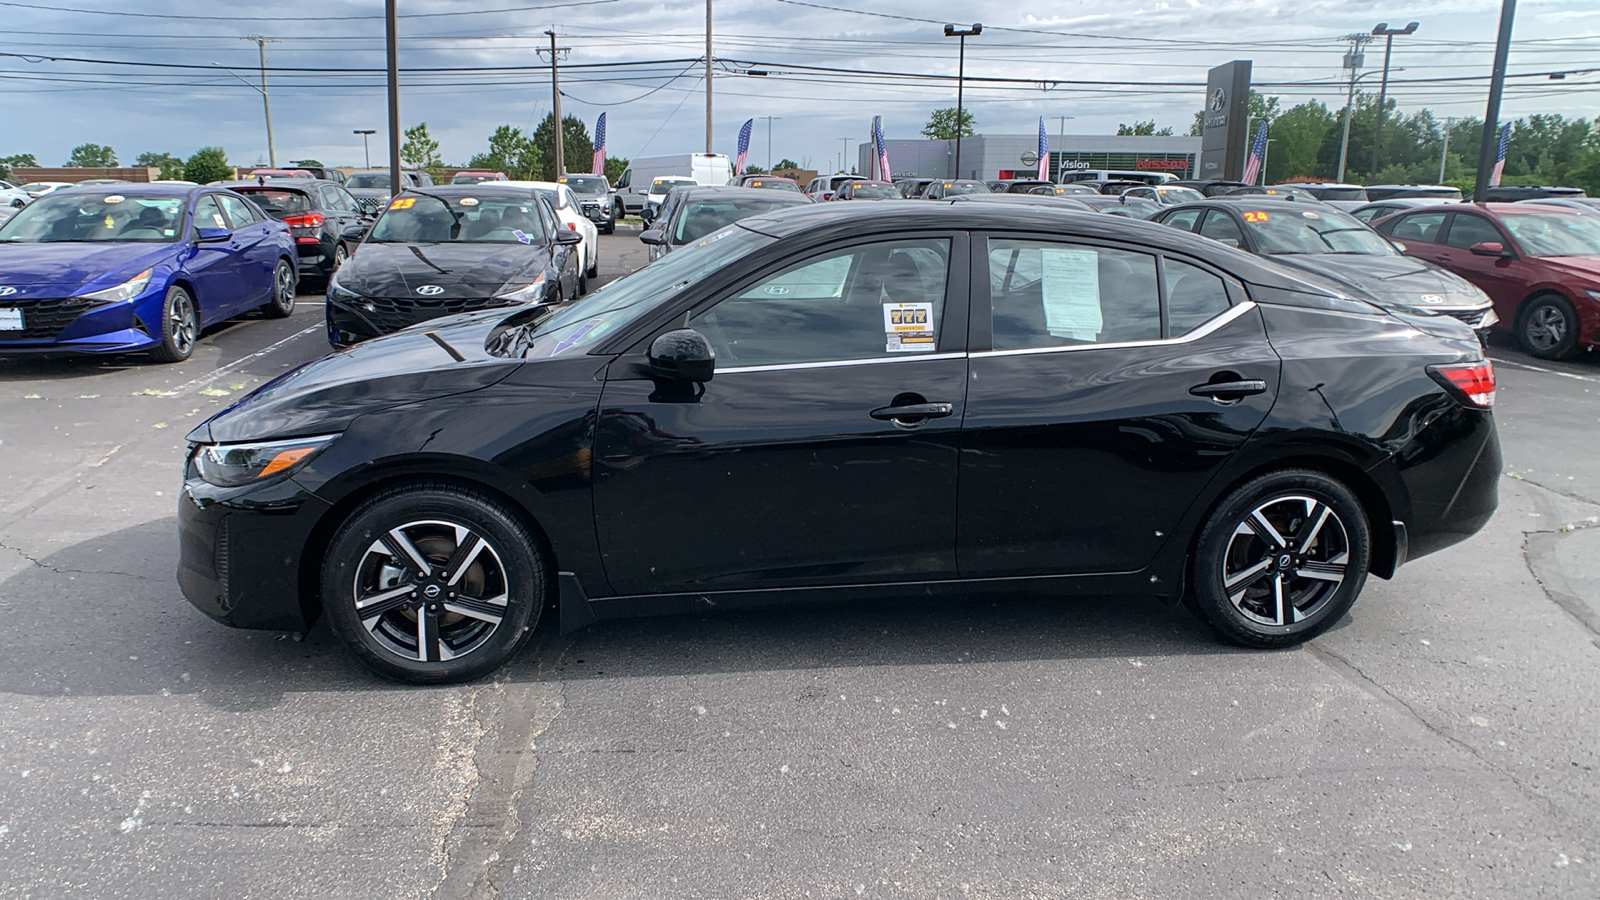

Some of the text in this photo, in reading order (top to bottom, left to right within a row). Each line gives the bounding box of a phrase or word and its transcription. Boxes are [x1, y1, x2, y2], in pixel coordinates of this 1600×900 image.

[1060, 160, 1090, 169] Vision
[1136, 159, 1189, 169] NISSAN
[390, 198, 416, 209] 23
[1243, 211, 1269, 222] 24
